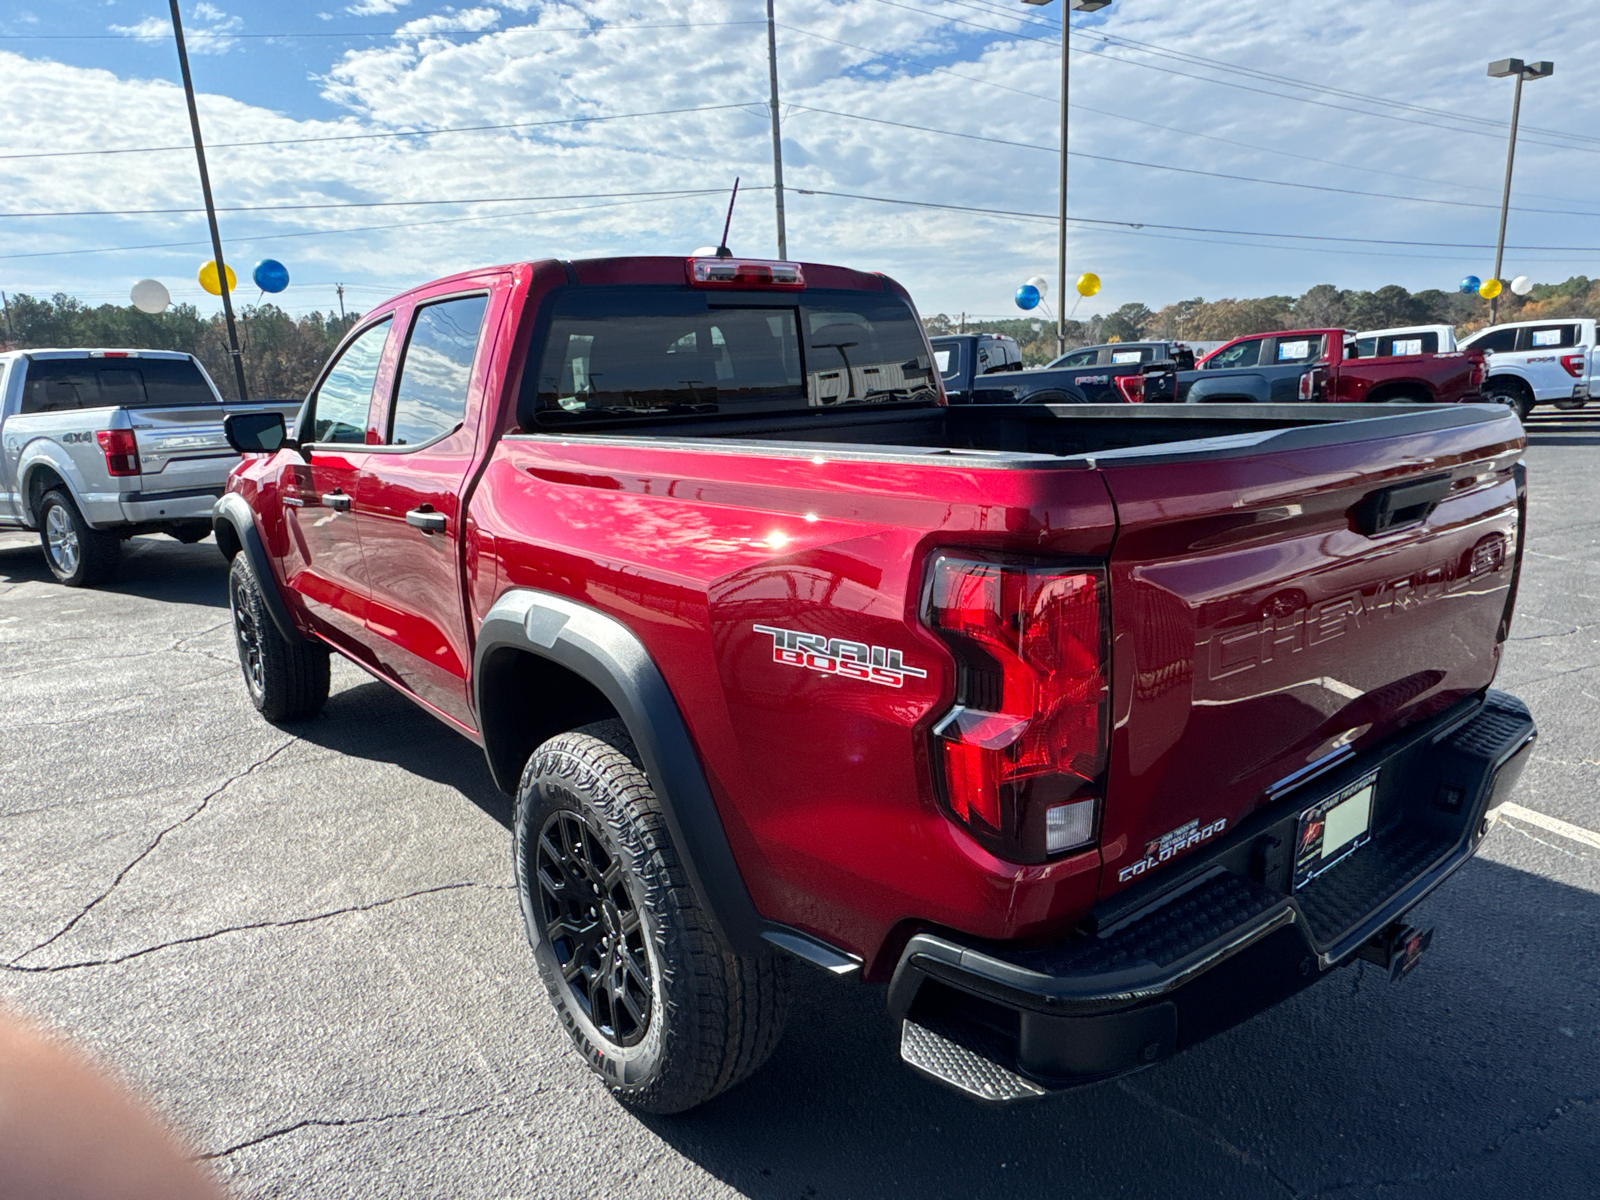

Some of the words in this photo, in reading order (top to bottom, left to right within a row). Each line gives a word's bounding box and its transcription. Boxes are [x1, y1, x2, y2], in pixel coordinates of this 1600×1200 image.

[753, 624, 928, 679] TRAIL
[773, 647, 904, 688] BOSS
[1118, 818, 1227, 882] COLORADO
